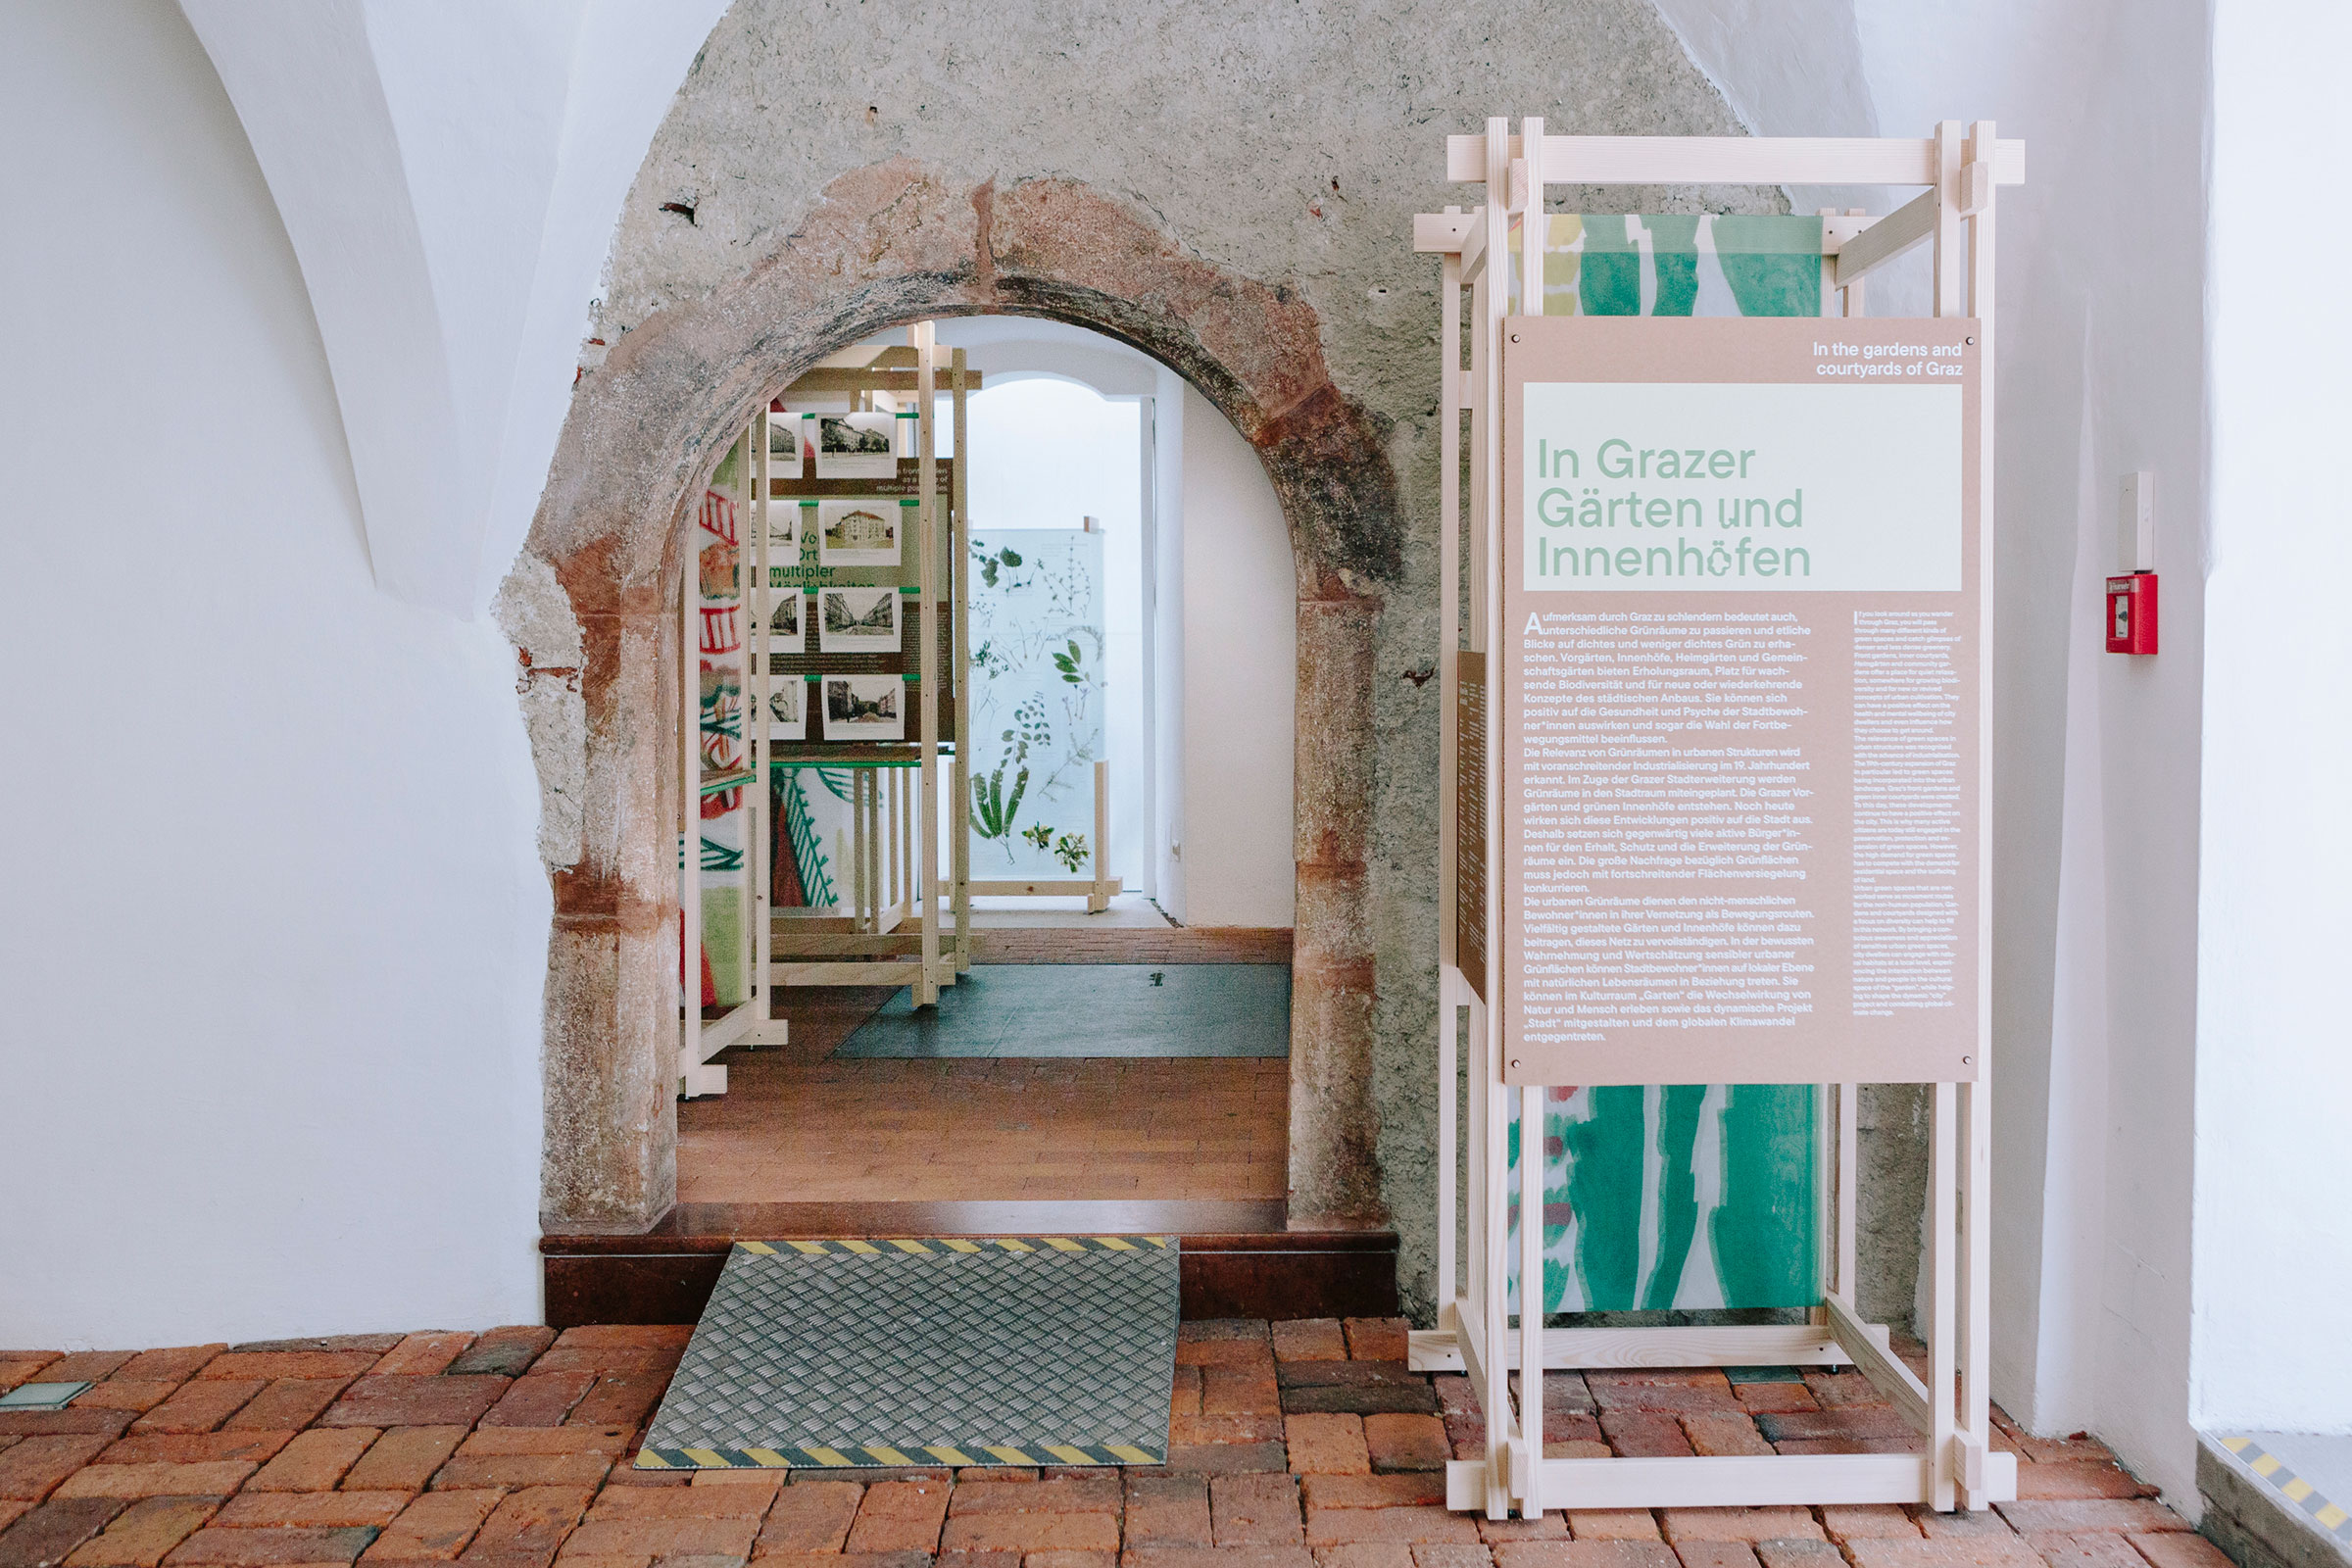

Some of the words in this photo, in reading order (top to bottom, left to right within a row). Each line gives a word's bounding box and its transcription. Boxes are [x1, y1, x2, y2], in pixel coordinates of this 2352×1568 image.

[1813, 341, 1829, 357] In
[1831, 341, 1860, 357] the
[1863, 341, 1929, 360] gardens
[1932, 341, 1962, 357] and
[1816, 361, 1902, 378] courtyards
[1905, 361, 1924, 376] of
[1926, 361, 1964, 376] Graz
[1540, 438, 1580, 478] In
[1597, 438, 1755, 479] Grazer
[1538, 487, 1702, 527] Gärten
[1718, 488, 1802, 529] und
[1540, 536, 1810, 577] Innenhöfen
[769, 564, 835, 580] multipler
[1598, 612, 1627, 621] durch
[1630, 612, 1652, 621] Graz
[1667, 612, 1722, 621] schlendern
[1725, 612, 1769, 621] bedeutet
[1543, 626, 1627, 635] unterschiedliche
[1631, 626, 1687, 635] Grünräume
[1703, 625, 1751, 637] passieren
[1754, 625, 1774, 635] und
[1776, 625, 1811, 635] etliche
[1524, 639, 1554, 649] Blicke
[1558, 639, 1574, 649] auf
[1577, 639, 1615, 649] dichtes
[1618, 639, 1638, 649] und
[1641, 639, 1682, 651] weniger
[1685, 639, 1722, 649] dichtes
[1725, 639, 1750, 649] Grün
[1676, 653, 1737, 664] Heimgärten
[1740, 653, 1759, 662] und
[1524, 666, 1593, 678] schaftsgärten
[1597, 666, 1630, 675] bieten
[1715, 666, 1740, 675] Platz
[1742, 666, 1756, 675] für
[1524, 680, 1555, 689] sende
[1559, 680, 1623, 689] Biodiversität
[1626, 680, 1645, 689] und
[1648, 680, 1662, 689] für
[1693, 680, 1717, 689] oder
[1720, 680, 1802, 689] wiederkehrende
[1524, 708, 1558, 718] positiv
[1562, 707, 1578, 716] auf
[1581, 707, 1596, 716] die
[1599, 707, 1658, 716] Gesundheit
[1661, 707, 1681, 716] und
[1684, 707, 1720, 718] Psyche
[1723, 707, 1740, 716] der
[1578, 720, 1629, 730] auswirken
[1633, 720, 1652, 730] und
[1655, 722, 1684, 732] sogar
[1687, 720, 1702, 729] die
[1705, 720, 1730, 729] Wahl
[1733, 720, 1750, 729] der
[1568, 775, 1580, 784] Im
[1584, 775, 1608, 786] Zuge
[1611, 775, 1629, 784] der
[1631, 774, 1664, 784] Grazer
[1667, 774, 1755, 786] Stadterweiterung
[1758, 774, 1795, 784] werden
[1524, 802, 1557, 813] gärten
[1560, 802, 1580, 811] und
[1584, 802, 1620, 813] grünen
[1623, 802, 1675, 810] Innenhöfe
[1735, 802, 1762, 810] Noch
[1765, 802, 1794, 810] heute
[1524, 829, 1564, 838] Deshalb
[1567, 829, 1599, 838] setzen
[1602, 829, 1623, 838] sich
[1625, 829, 1688, 840] gegenwärtig
[1690, 829, 1713, 838] viele
[1716, 828, 1745, 838] aktive
[1524, 857, 1555, 865] räume
[1579, 857, 1595, 865] Die
[1597, 856, 1627, 867] große
[1631, 856, 1682, 867] Nachfrage
[1685, 856, 1733, 867] bezüglich
[1737, 856, 1798, 864] Grünflächen
[1553, 869, 1589, 881] jedoch
[1592, 869, 1608, 879] mit
[1611, 869, 1695, 878] fortschreitender
[1698, 869, 1805, 880] Flächenversiegelung
[1523, 897, 1540, 906] Die
[1543, 897, 1583, 906] urbanen
[1586, 897, 1640, 906] Grünräume
[1642, 897, 1676, 906] dienen
[1678, 897, 1697, 906] den
[1523, 924, 1568, 935] Vielfältig
[1570, 924, 1621, 935] gestaltete
[1624, 923, 1658, 933] Gärten
[1661, 923, 1681, 933] und
[1684, 923, 1735, 932] Innenhöfe
[1738, 923, 1774, 932] können
[1777, 923, 1801, 932] dazu
[1523, 951, 1599, 962] Wahrnehmung
[1602, 951, 1622, 959] und
[1625, 951, 1702, 961] Wertschätzung
[1705, 951, 1751, 959] sensibler
[1754, 951, 1795, 959] urbaner
[1523, 992, 1562, 1001] können
[1565, 992, 1577, 1001] im
[1580, 992, 1637, 1001] Kulturraum
[1688, 991, 1703, 1001] die
[1705, 991, 1789, 1003] Wechselwirkung
[1523, 1005, 1552, 1014] Natur
[1554, 1005, 1574, 1014] und
[1577, 1005, 1617, 1014] Mensch
[1620, 1004, 1659, 1014] erleben
[1662, 1004, 1690, 1013] sowie
[1693, 1004, 1711, 1013] das
[1714, 1004, 1774, 1015] dynamische
[1778, 1004, 1812, 1015] Projekt
[1564, 1018, 1629, 1030] mitgestalten
[1633, 1018, 1652, 1027] und
[1655, 1018, 1678, 1027] dem
[1682, 1018, 1727, 1029] globalen
[1730, 1018, 1795, 1027] Klimawandel
